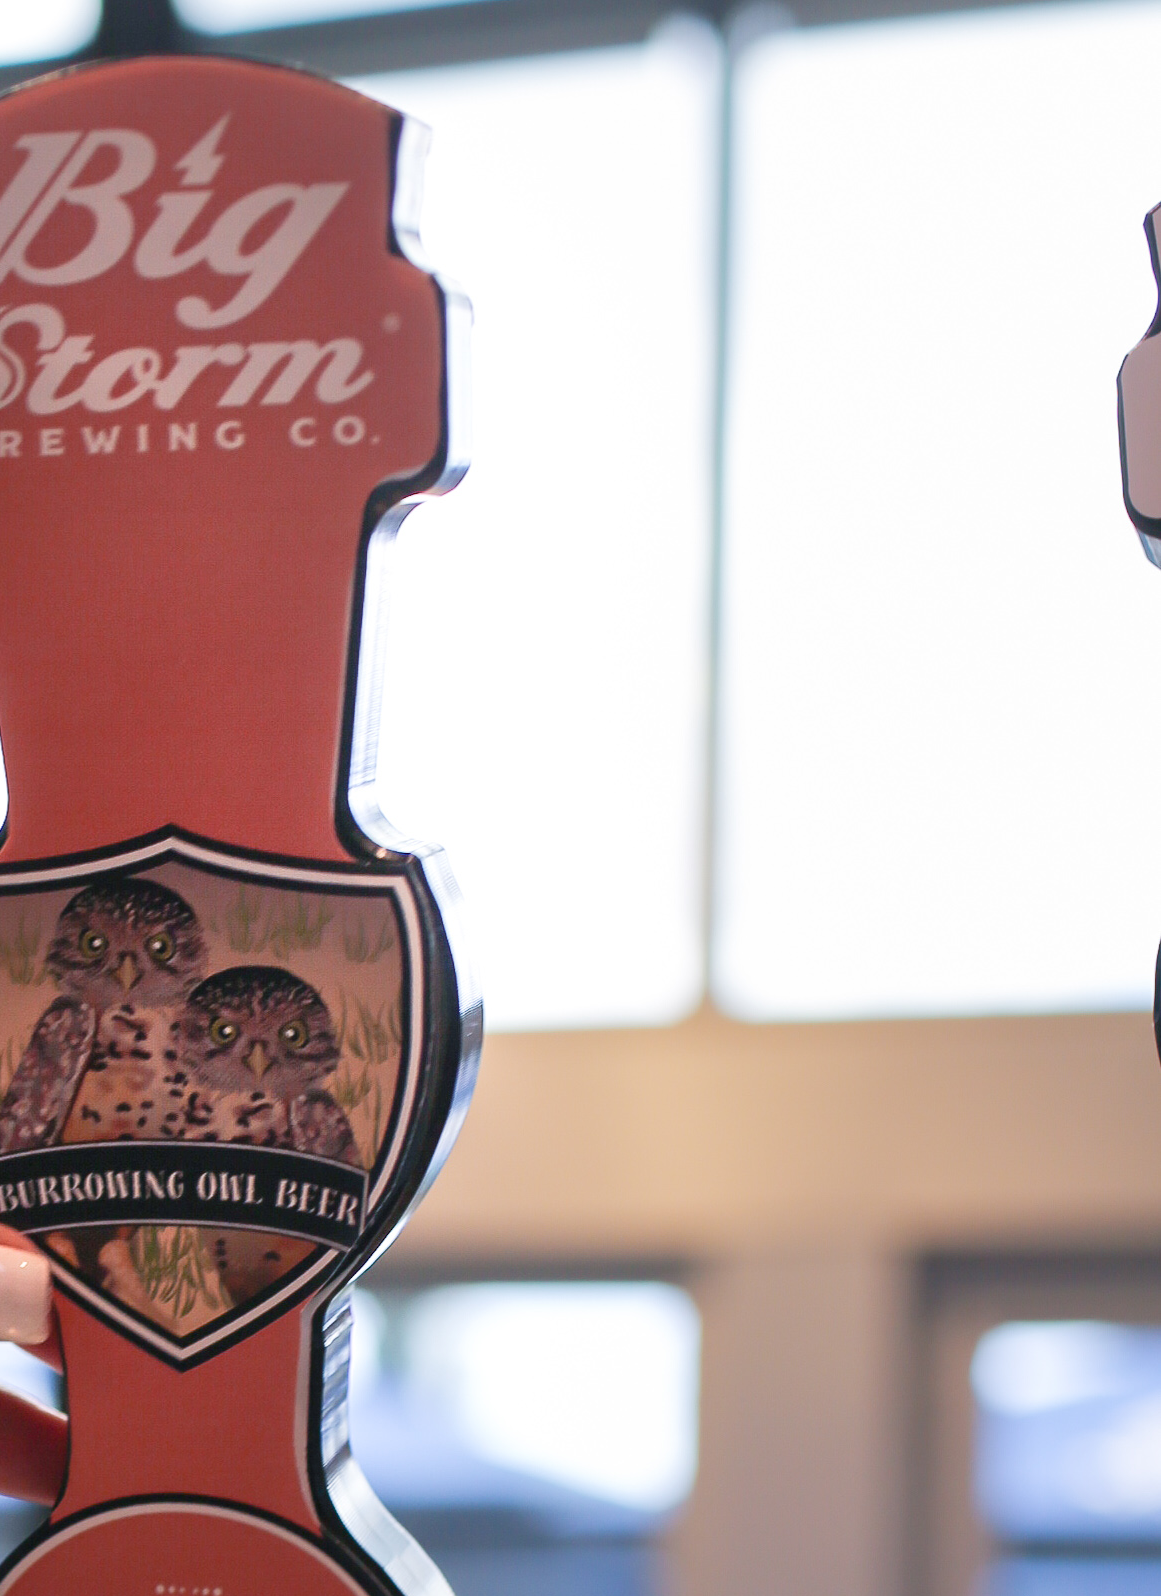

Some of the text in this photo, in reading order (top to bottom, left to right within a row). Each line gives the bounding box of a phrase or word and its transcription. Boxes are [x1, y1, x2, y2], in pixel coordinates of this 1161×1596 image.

[289, 415, 381, 447] CO.
[196, 1171, 262, 1205] OWL
[275, 1179, 360, 1227] BEER
